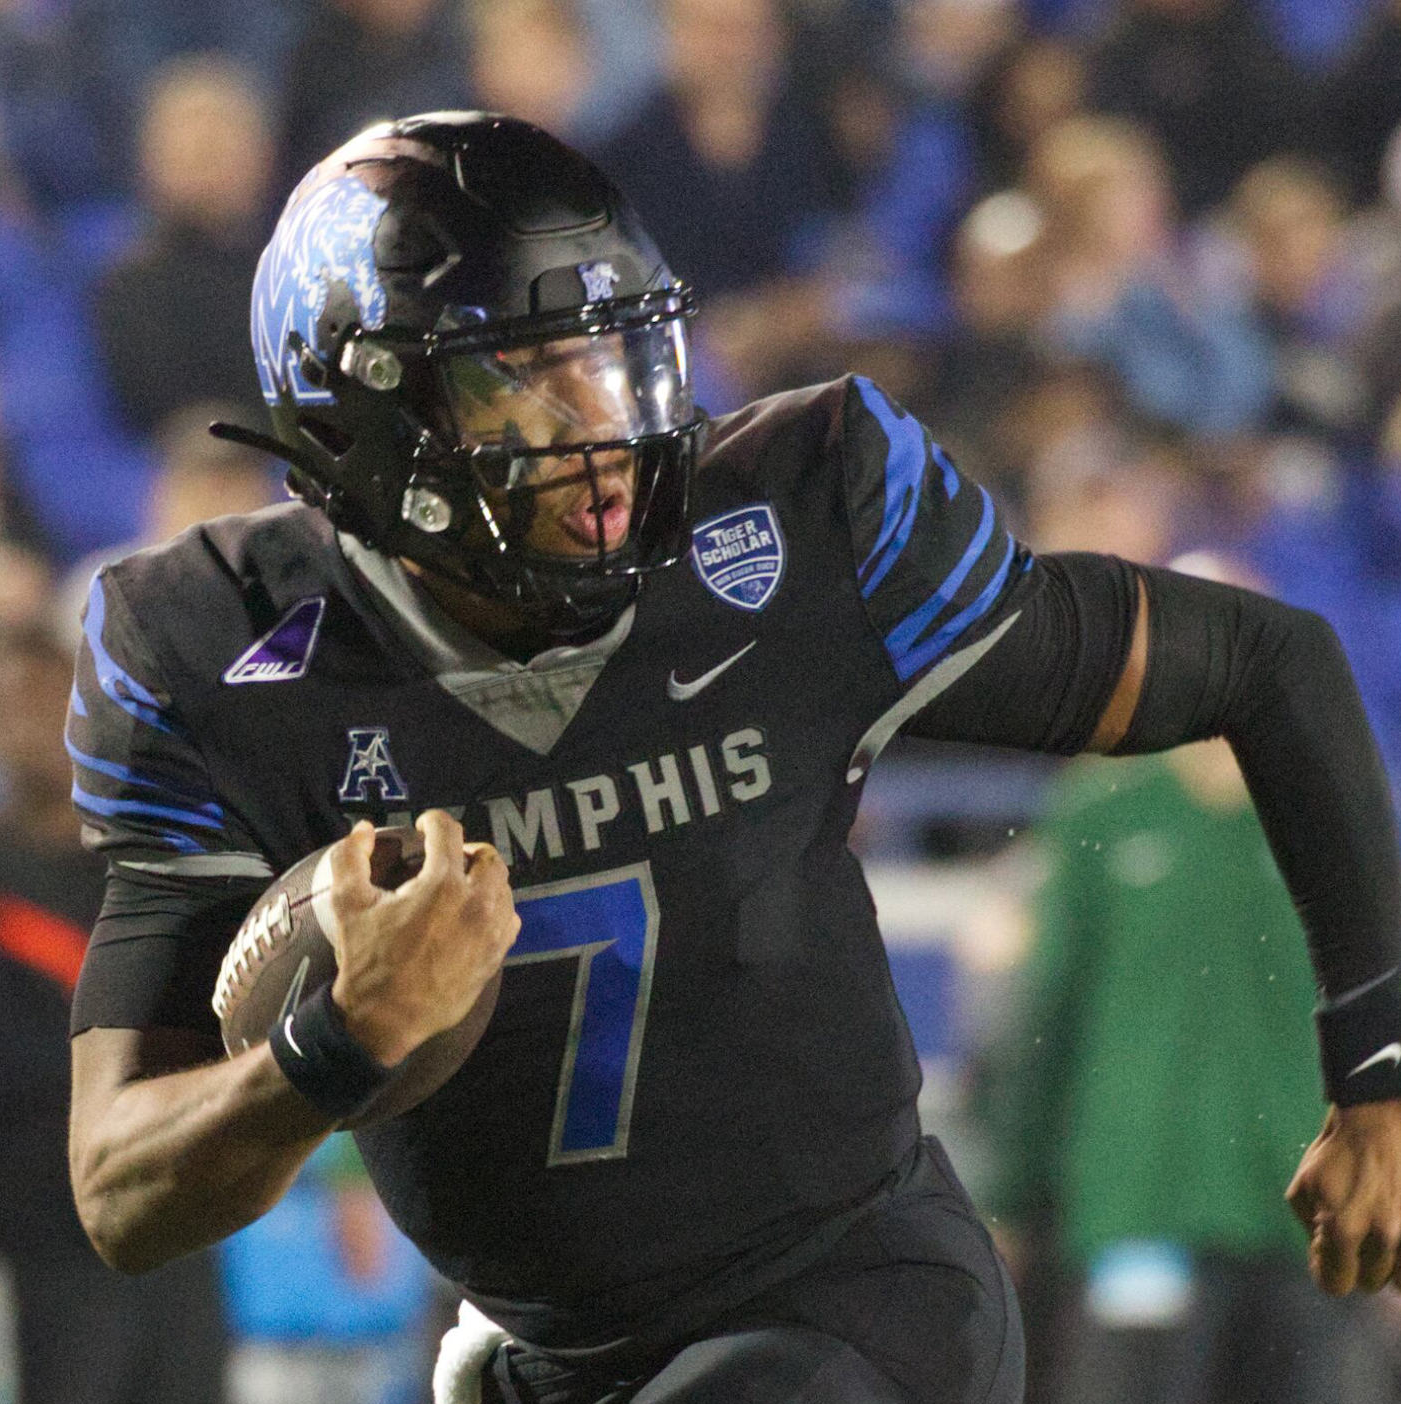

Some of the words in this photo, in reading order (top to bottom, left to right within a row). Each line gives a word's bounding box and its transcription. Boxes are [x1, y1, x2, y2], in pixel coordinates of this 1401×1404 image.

[701, 530, 773, 566] SCHOLAR
[706, 520, 757, 547] TIGER
[339, 726, 408, 801] A
[344, 727, 773, 867] MPHIS
[502, 860, 661, 1168] 7
